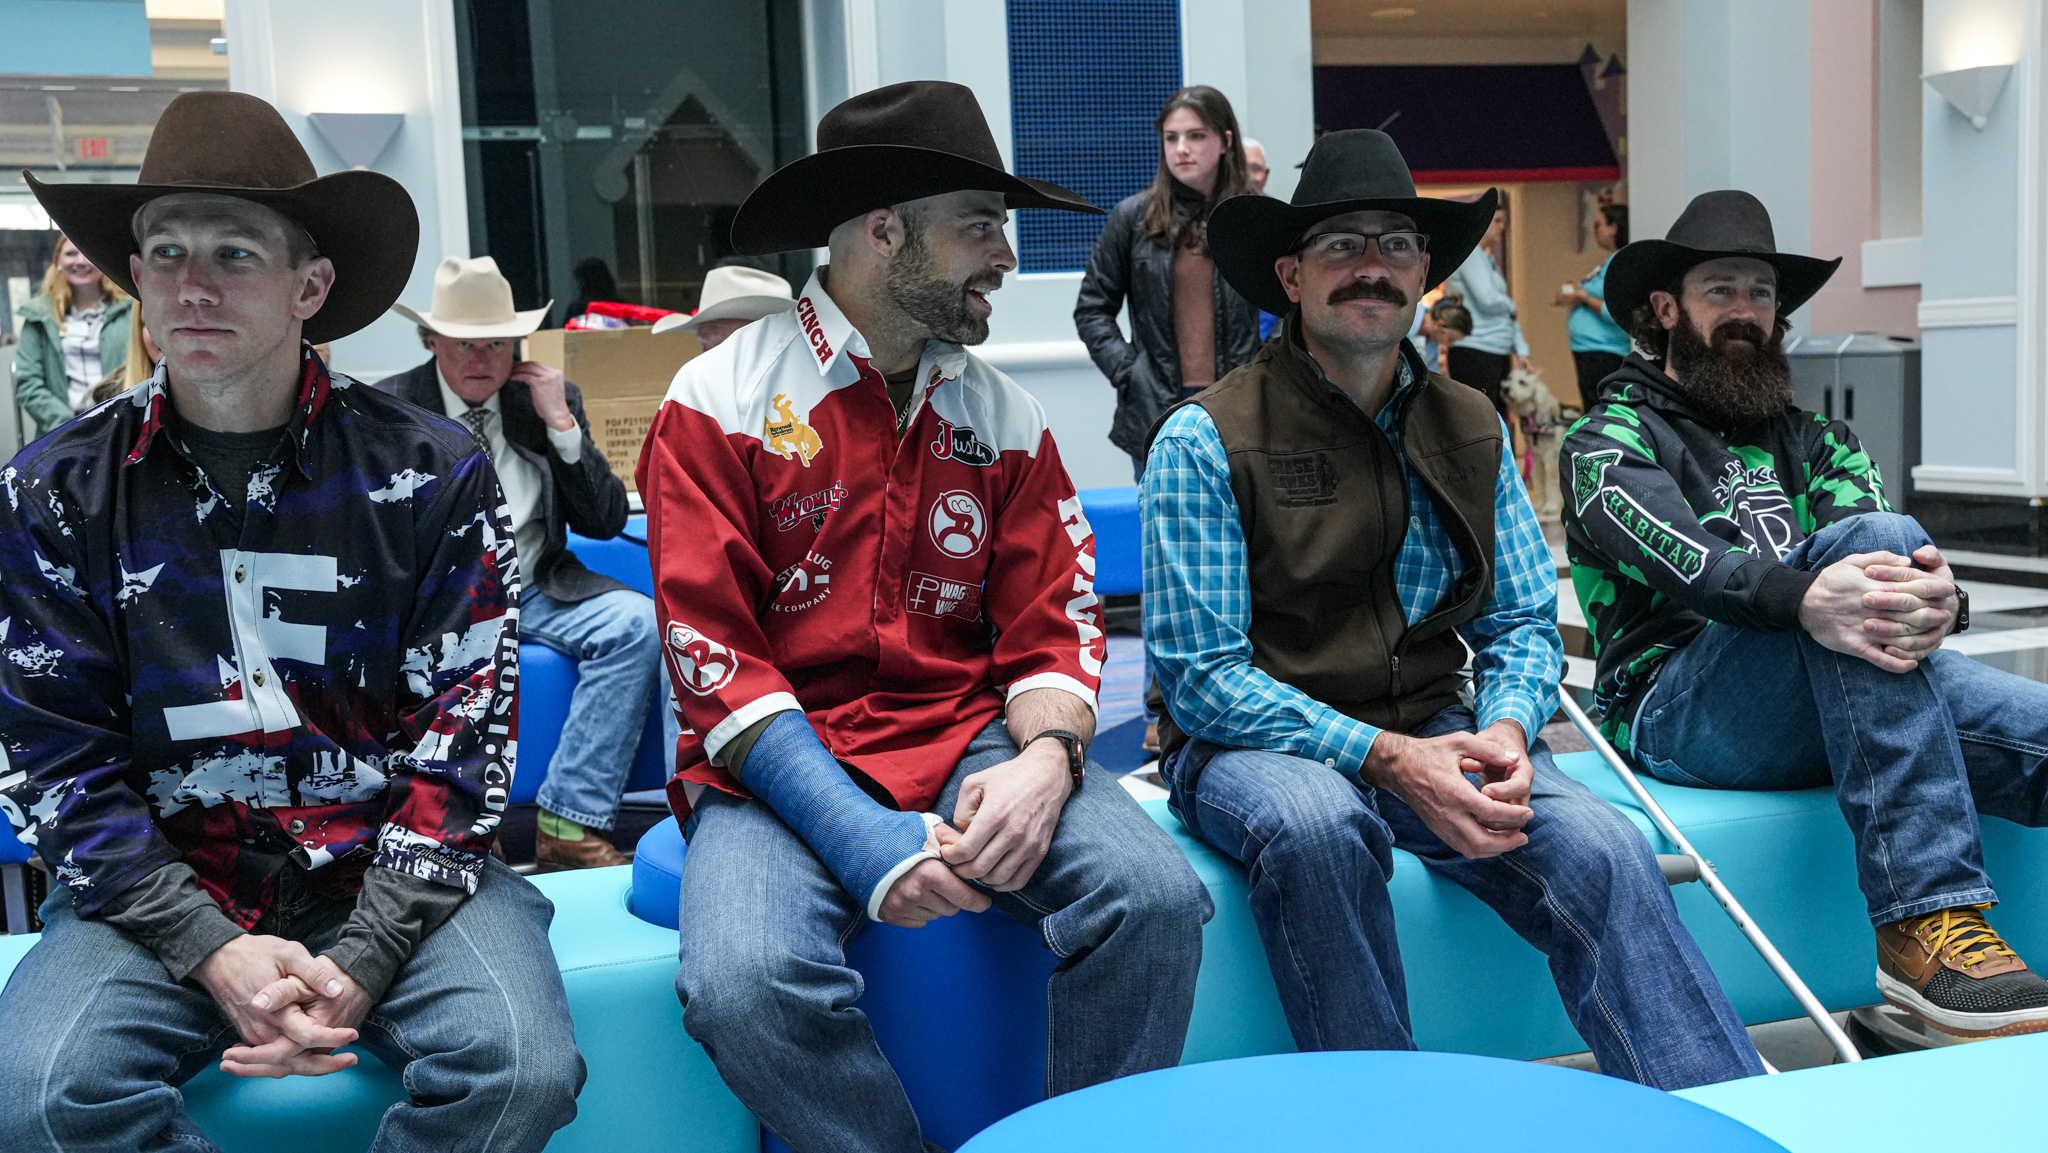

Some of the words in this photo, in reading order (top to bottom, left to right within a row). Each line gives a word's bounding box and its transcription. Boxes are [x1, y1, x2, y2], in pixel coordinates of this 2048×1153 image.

[797, 297, 833, 366] CINCH
[1608, 493, 1699, 572] HABITAT
[784, 587, 832, 613] COMPANY
[411, 845, 463, 870] Ephesians
